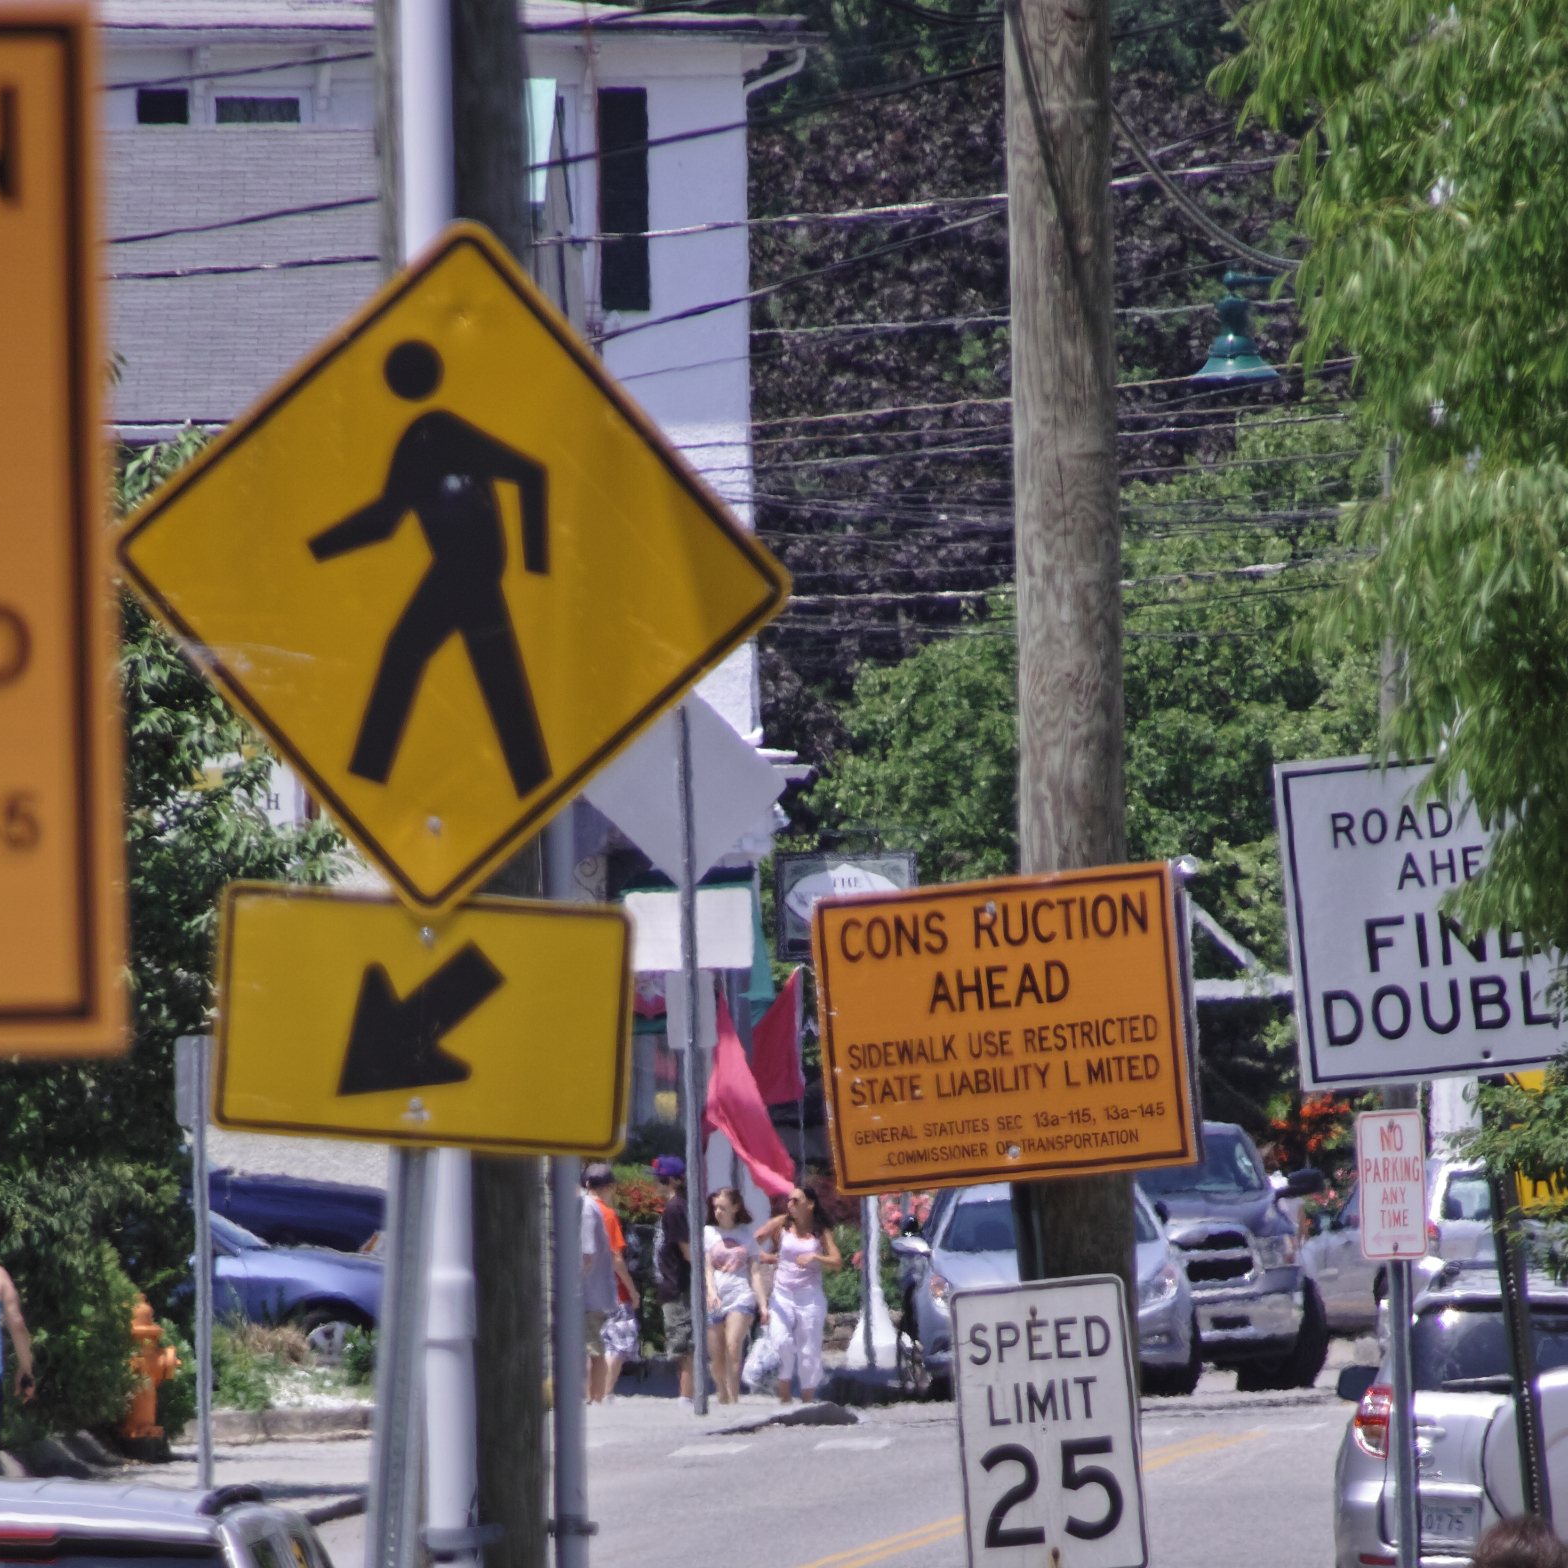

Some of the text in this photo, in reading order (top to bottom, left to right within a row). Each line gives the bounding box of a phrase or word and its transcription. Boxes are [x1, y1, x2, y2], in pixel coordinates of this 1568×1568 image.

[1330, 802, 1452, 848] ROAD
[1397, 845, 1483, 890] AHE
[840, 890, 1149, 963] CONSRUCTION
[1365, 910, 1541, 973] FINE
[929, 960, 1070, 1014] AHEAD
[1323, 970, 1554, 1047] DOUBL
[848, 1014, 1158, 1070] SIDEWALK USE RESTRICTED
[850, 1054, 1160, 1106] STATE LIABILITY LMITED
[854, 1125, 917, 1146] GENERAL
[924, 1118, 989, 1138] STATUTES
[1104, 1102, 1165, 1121] 13a-145
[887, 1143, 988, 1166] COMMISSIONER
[1021, 1129, 1139, 1153] TRANSPORTATION
[1380, 1124, 1404, 1152] NO
[1364, 1156, 1420, 1183] PARKING
[1380, 1209, 1409, 1228] TIME
[1382, 1186, 1406, 1204] ANY
[969, 1315, 1111, 1365] SPEED
[987, 1376, 1097, 1426] LIMIT
[980, 1436, 1123, 1548] 25
